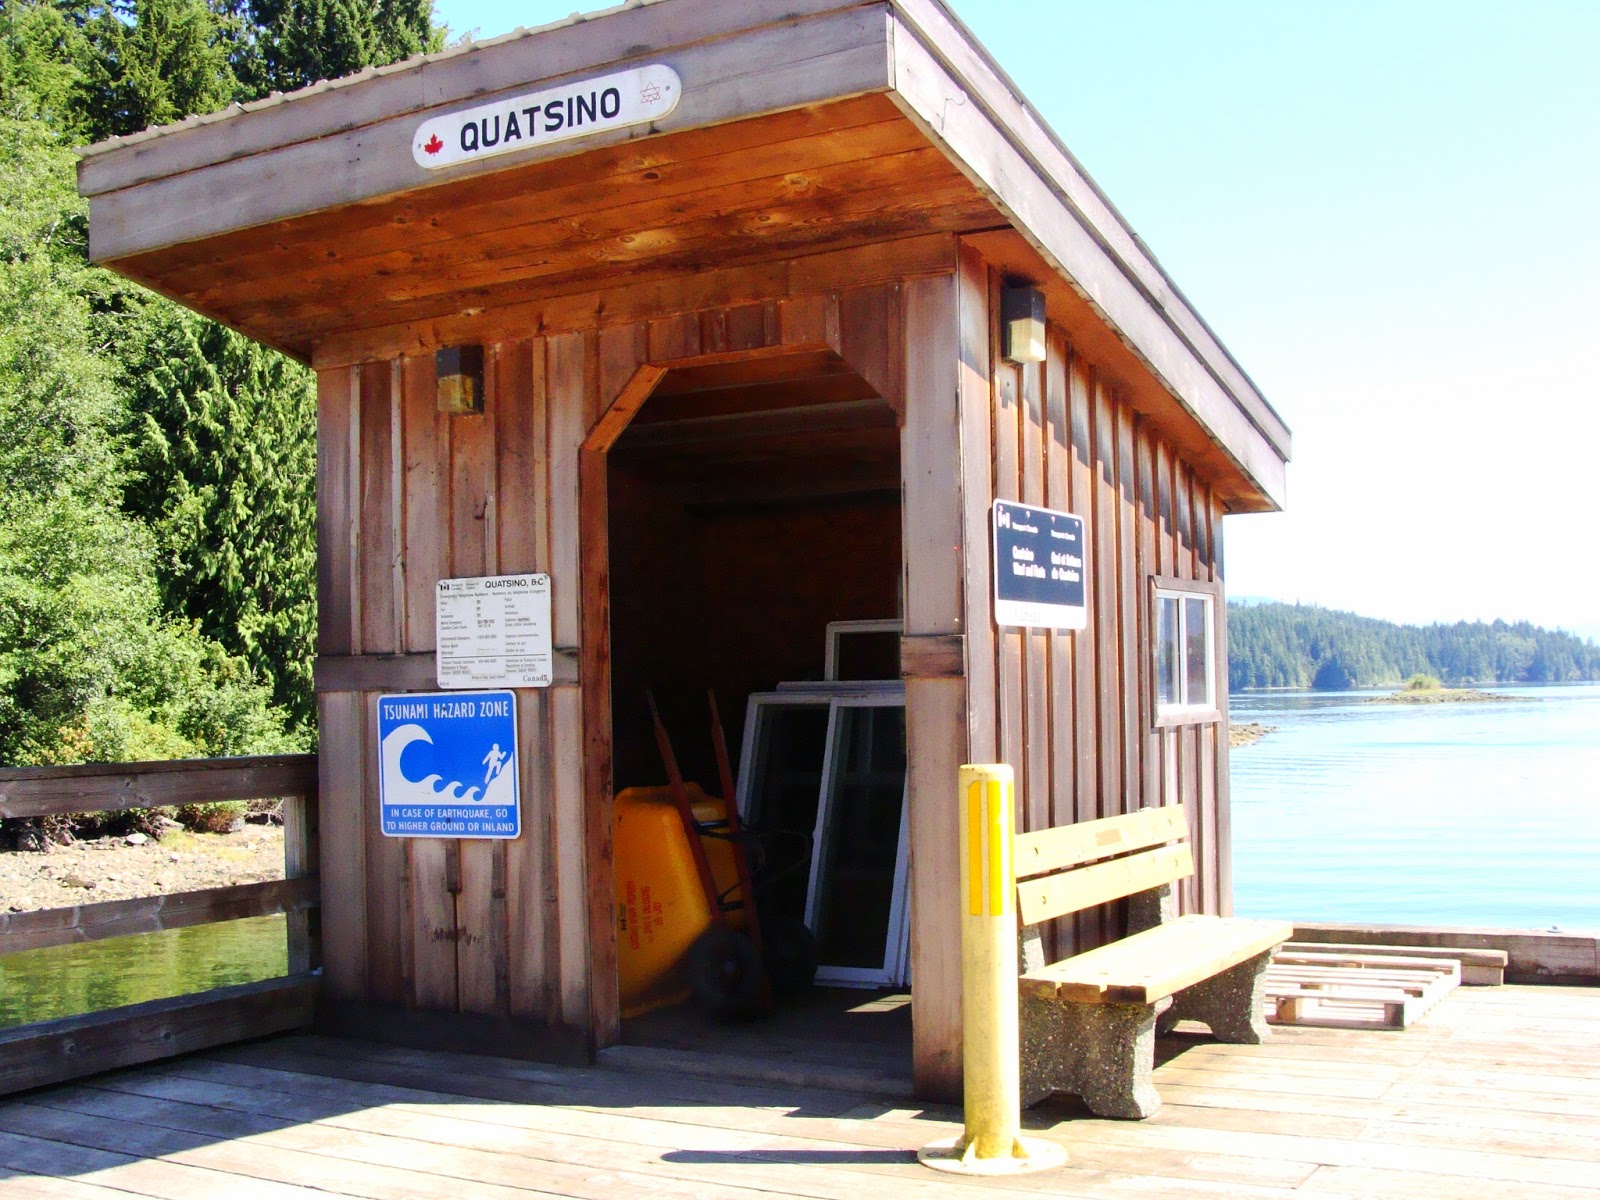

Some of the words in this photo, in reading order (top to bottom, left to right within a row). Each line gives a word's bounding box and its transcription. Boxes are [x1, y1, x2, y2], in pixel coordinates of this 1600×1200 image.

[460, 87, 621, 152] QUATSINO
[485, 579, 528, 589] QUATSINO,
[384, 704, 428, 720] TSUNAMI
[433, 702, 475, 718] HAZARD
[480, 701, 509, 717] ZONE
[391, 809, 399, 817] IN
[402, 809, 421, 818] CASE
[425, 809, 435, 818] OF
[438, 809, 492, 819] EARTHQUAKE,
[495, 808, 508, 817] GO
[386, 821, 395, 830] TO
[399, 821, 428, 830] HIGHER
[431, 822, 465, 831] GROUND
[468, 822, 479, 831] OR
[482, 822, 514, 832] INLAND
